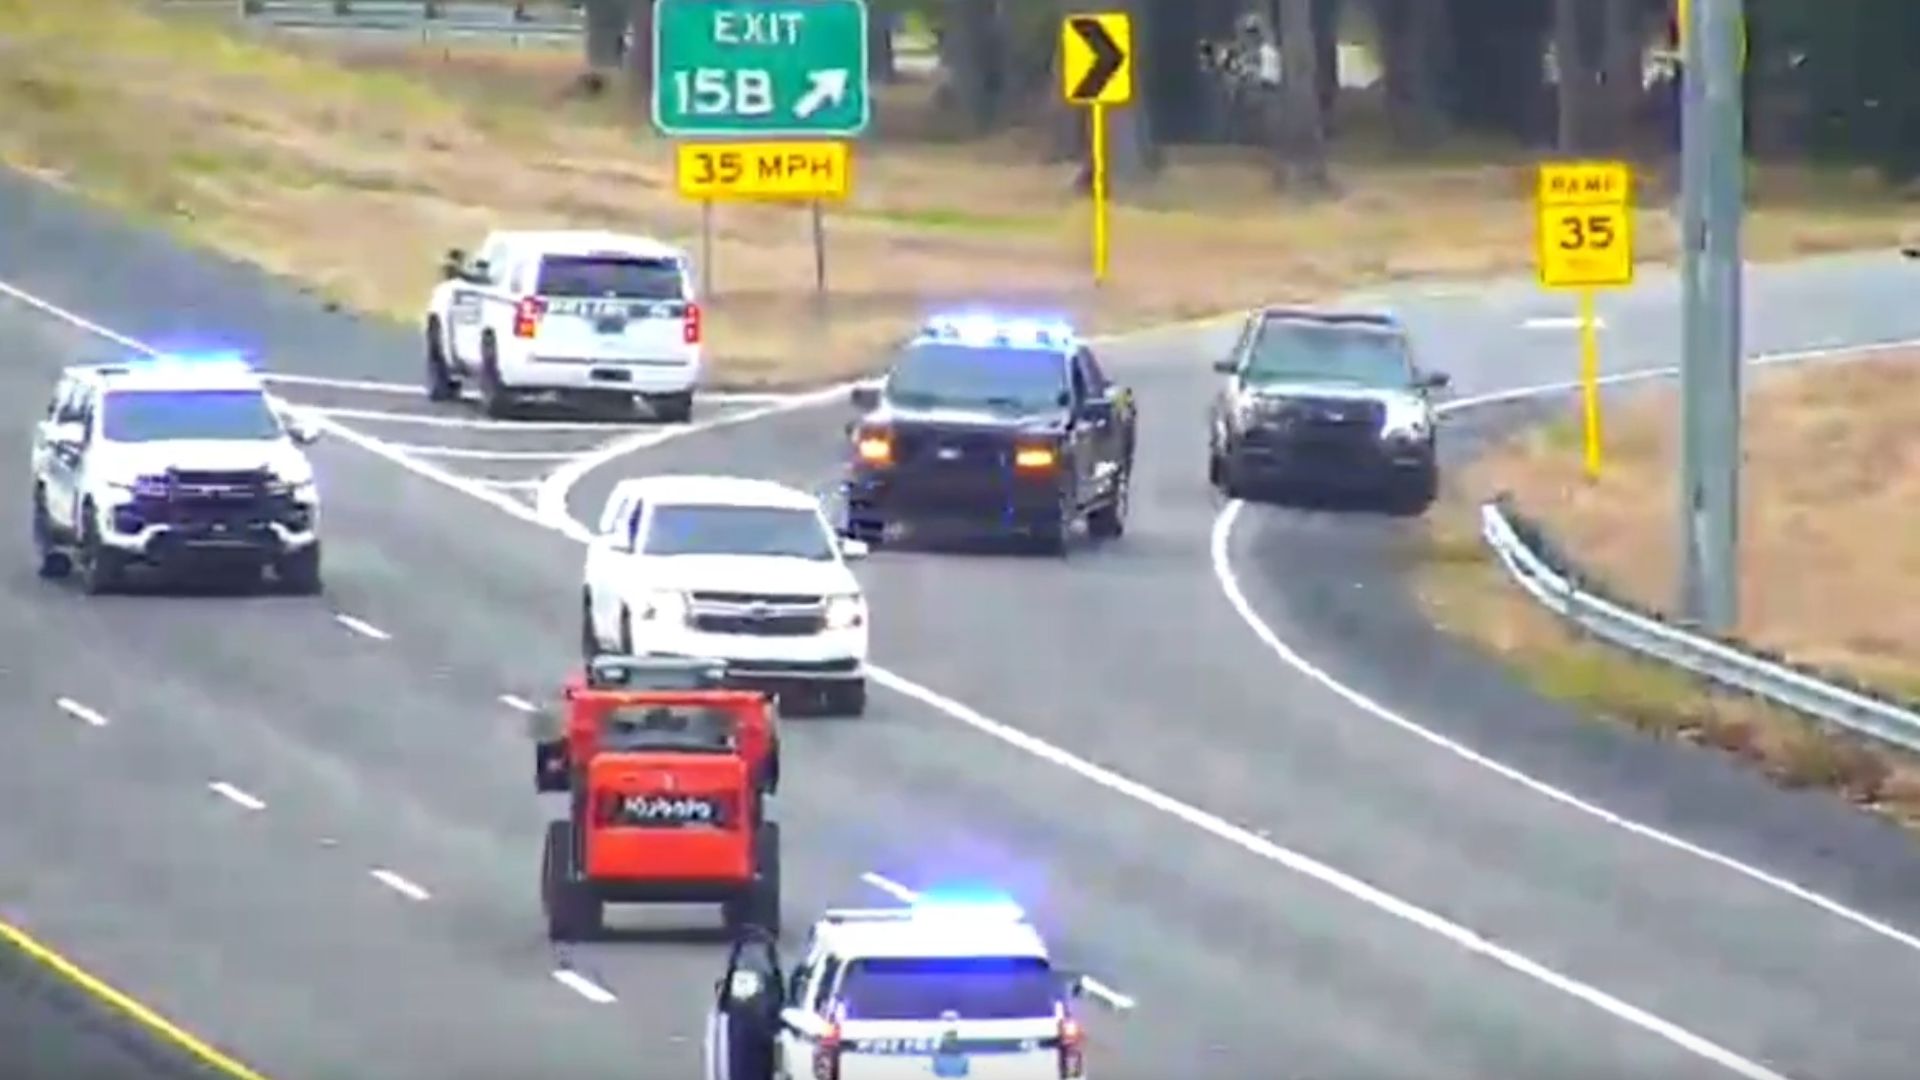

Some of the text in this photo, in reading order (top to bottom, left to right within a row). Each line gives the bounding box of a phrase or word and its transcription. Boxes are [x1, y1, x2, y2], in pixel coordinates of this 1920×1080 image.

[714, 11, 804, 44] EXIT
[674, 68, 774, 114] 15B
[694, 153, 833, 183] 35 MPH
[1560, 216, 1615, 250] 35
